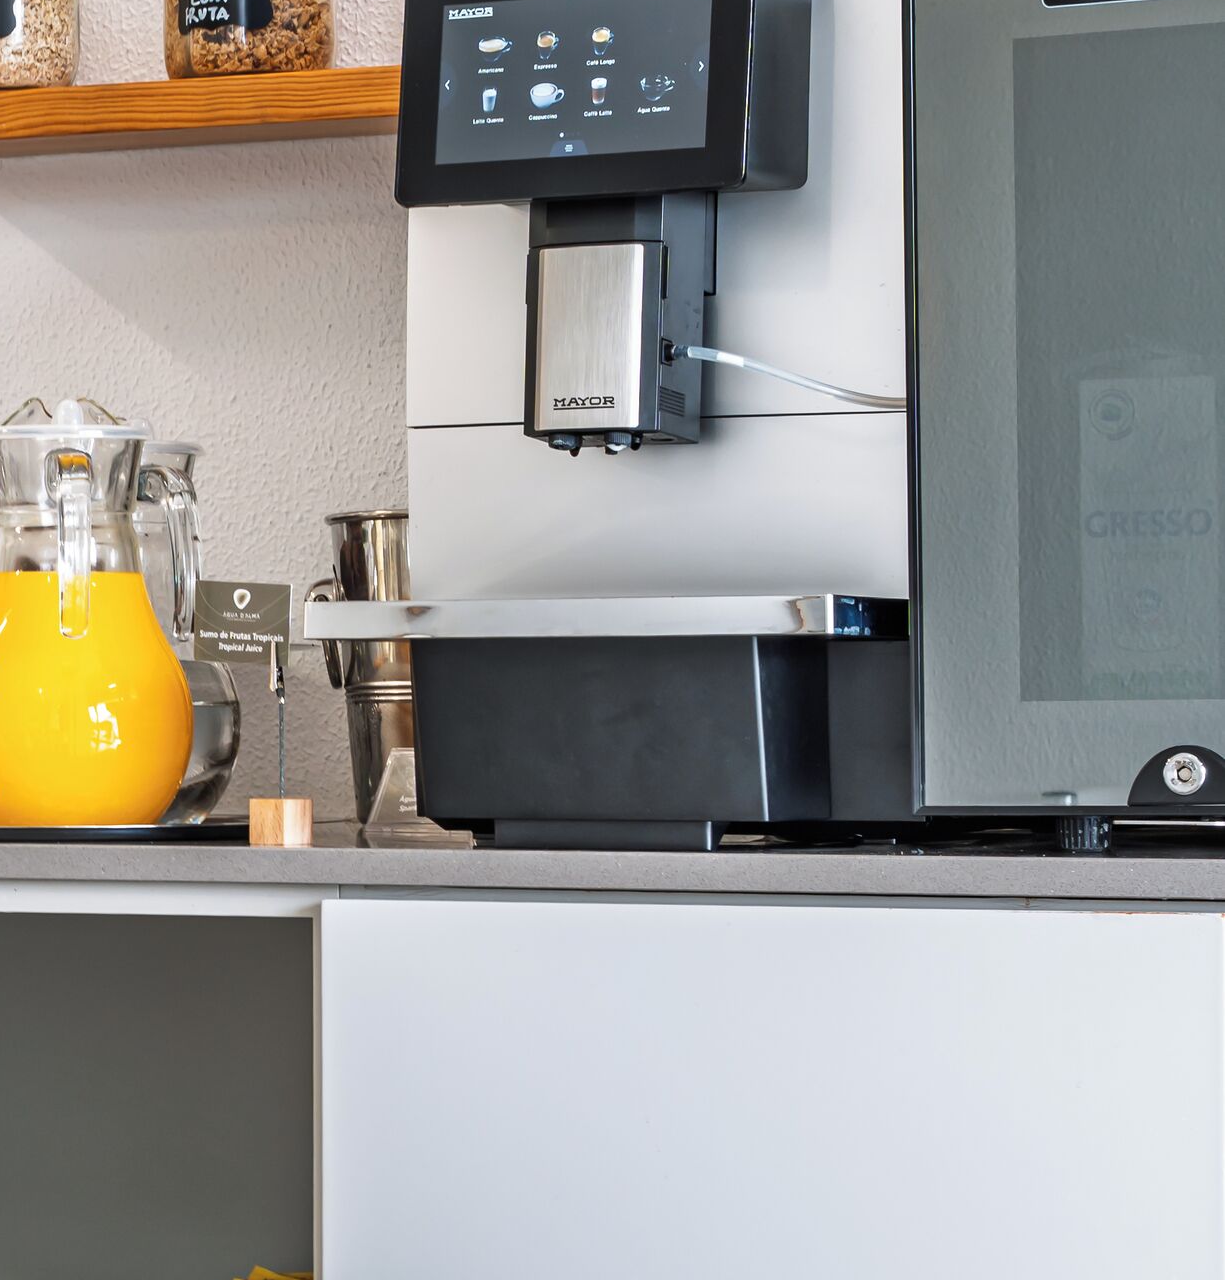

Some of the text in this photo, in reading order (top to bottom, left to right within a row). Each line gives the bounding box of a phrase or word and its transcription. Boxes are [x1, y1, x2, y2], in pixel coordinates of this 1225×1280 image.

[448, 6, 493, 20] MAYOR
[553, 396, 615, 408] MAYOR
[199, 629, 284, 644] Sumo de Frutas Tropicais
[218, 642, 263, 653] Tropical Juice
